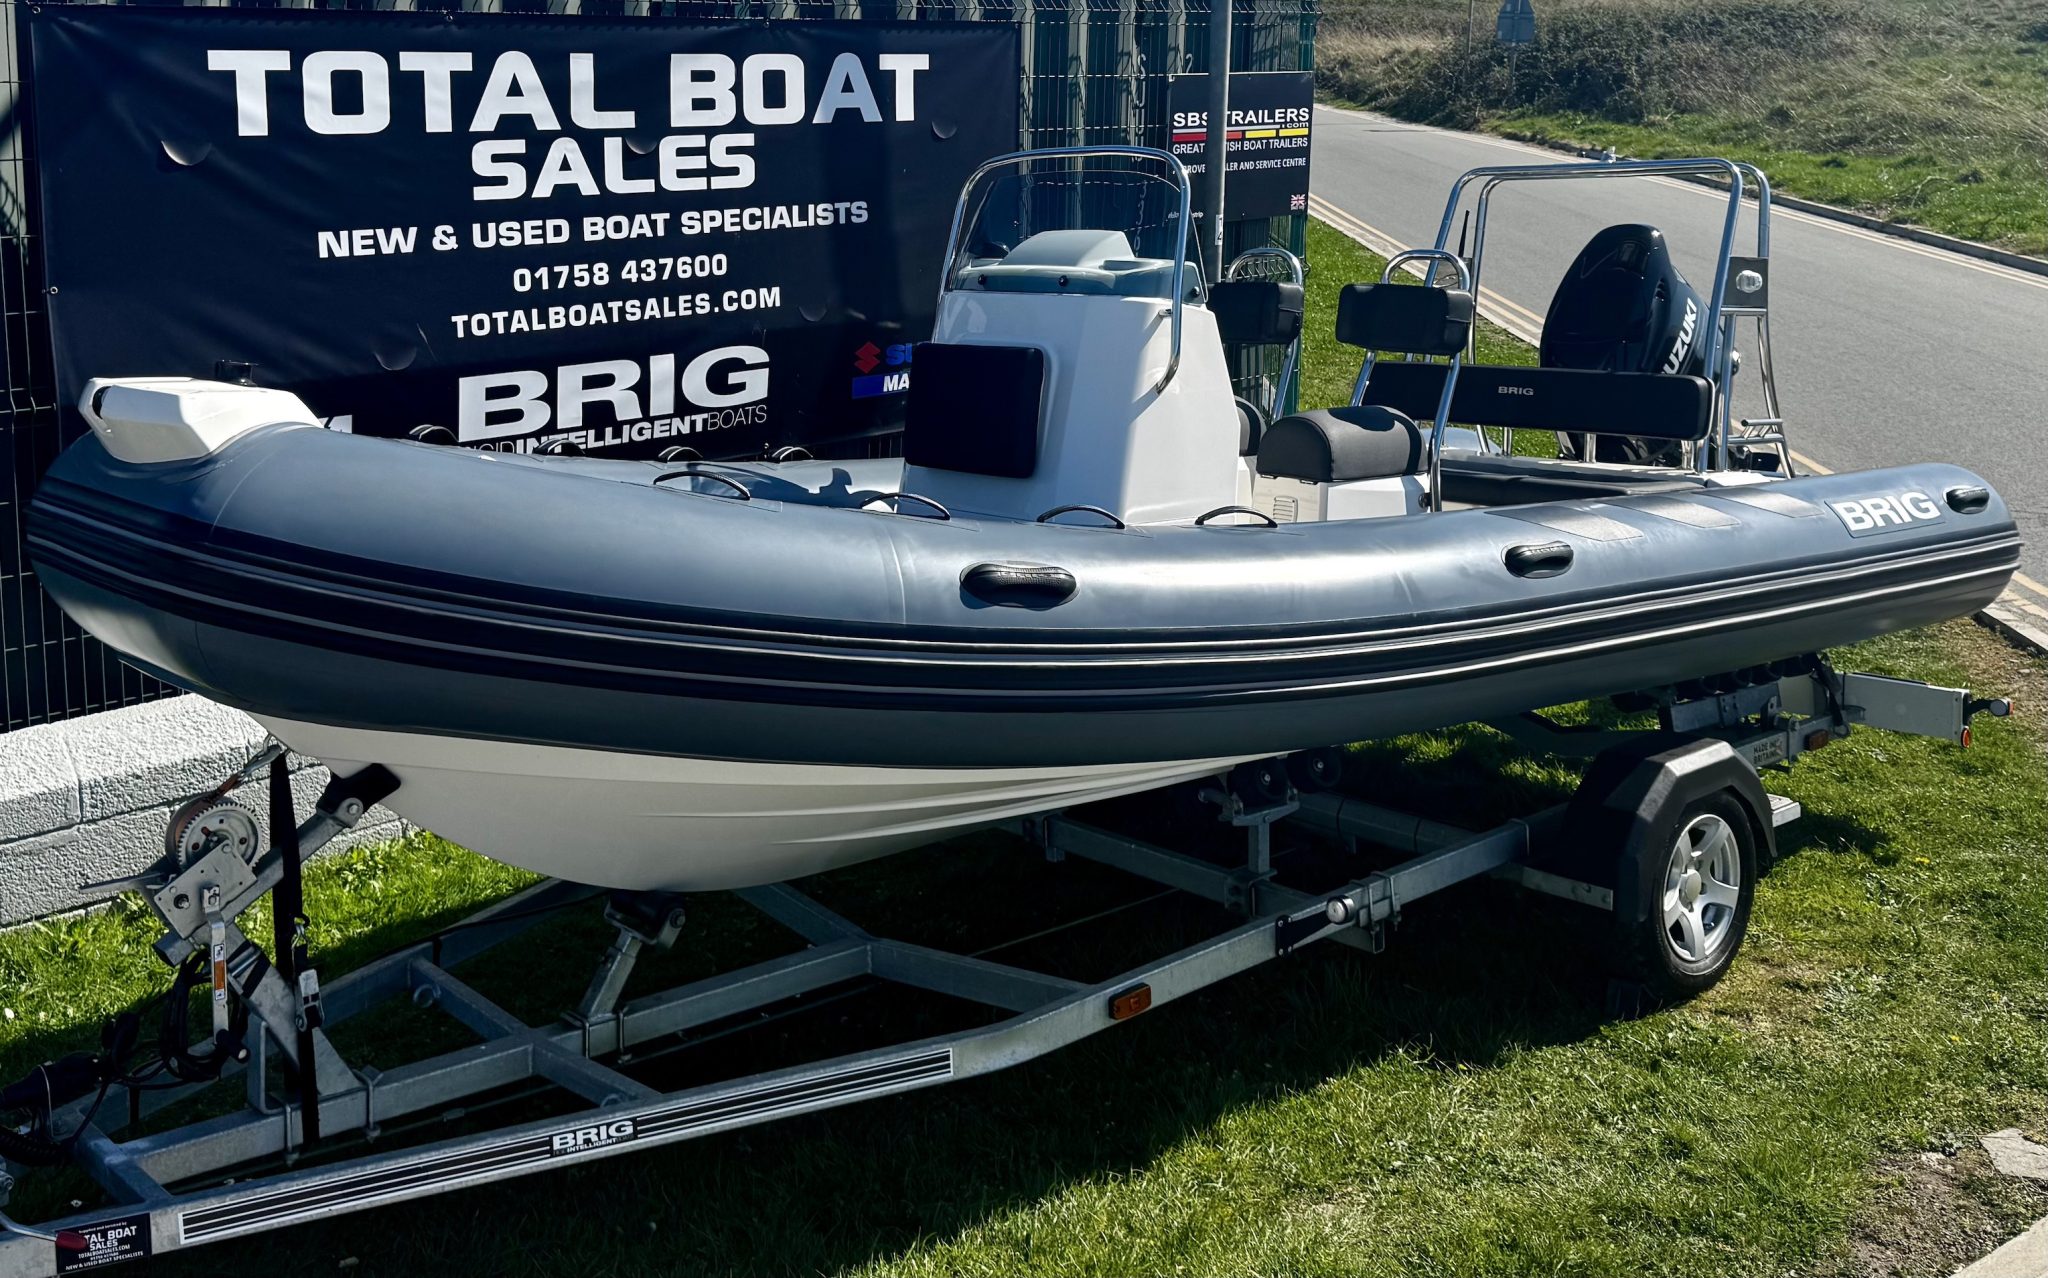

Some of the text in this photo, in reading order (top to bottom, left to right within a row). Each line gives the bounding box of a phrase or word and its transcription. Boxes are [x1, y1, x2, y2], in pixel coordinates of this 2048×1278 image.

[207, 50, 930, 136] TOTAL BOAT
[1173, 143, 1205, 155] GREAT
[1244, 139, 1267, 151] BOAT
[1269, 137, 1308, 149] TRAILERS
[1239, 161, 1254, 171] AND
[1256, 159, 1282, 170] SERVICE
[1283, 157, 1307, 168] CENTRE
[471, 133, 756, 201] SALES
[318, 201, 868, 259] NEW & USED BOAT SPECIALISTS
[513, 253, 728, 292] 01758 437600
[451, 286, 781, 339] TOTALBOATSALES.COM
[1661, 297, 1698, 375] UZUKI
[459, 345, 770, 443] BRIG
[1498, 386, 1534, 396] BRIG
[1830, 491, 1942, 531] BRIG
[552, 1120, 634, 1150] BRIG
[84, 1226, 137, 1244] TAL BOAT
[90, 1239, 118, 1251] SALES
